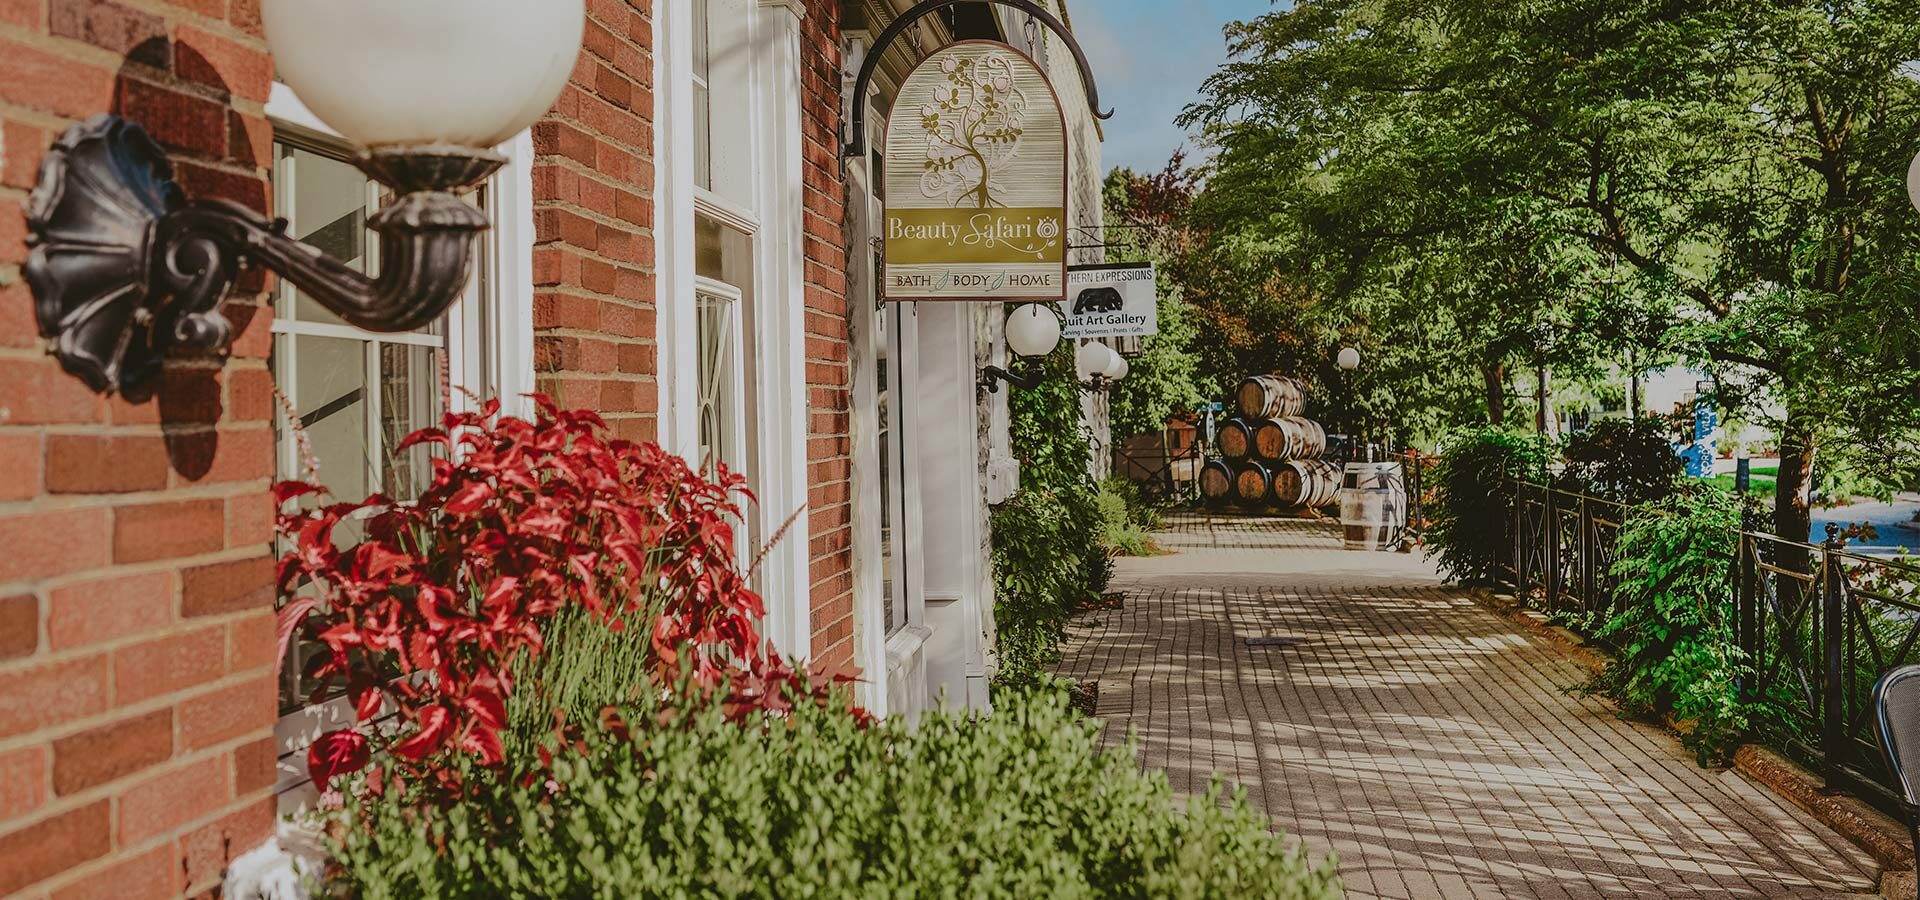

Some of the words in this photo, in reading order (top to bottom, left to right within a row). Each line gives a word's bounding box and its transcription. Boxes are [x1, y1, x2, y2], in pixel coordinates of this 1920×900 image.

[888, 217, 961, 246] Beauty
[963, 213, 1032, 249] Safari
[896, 275, 931, 287] BATH
[953, 274, 990, 286] BODY
[1009, 274, 1051, 286] HOME
[1095, 270, 1153, 282] EXPRESSIONS
[1086, 315, 1104, 325] Art
[1106, 313, 1147, 326] Gallery
